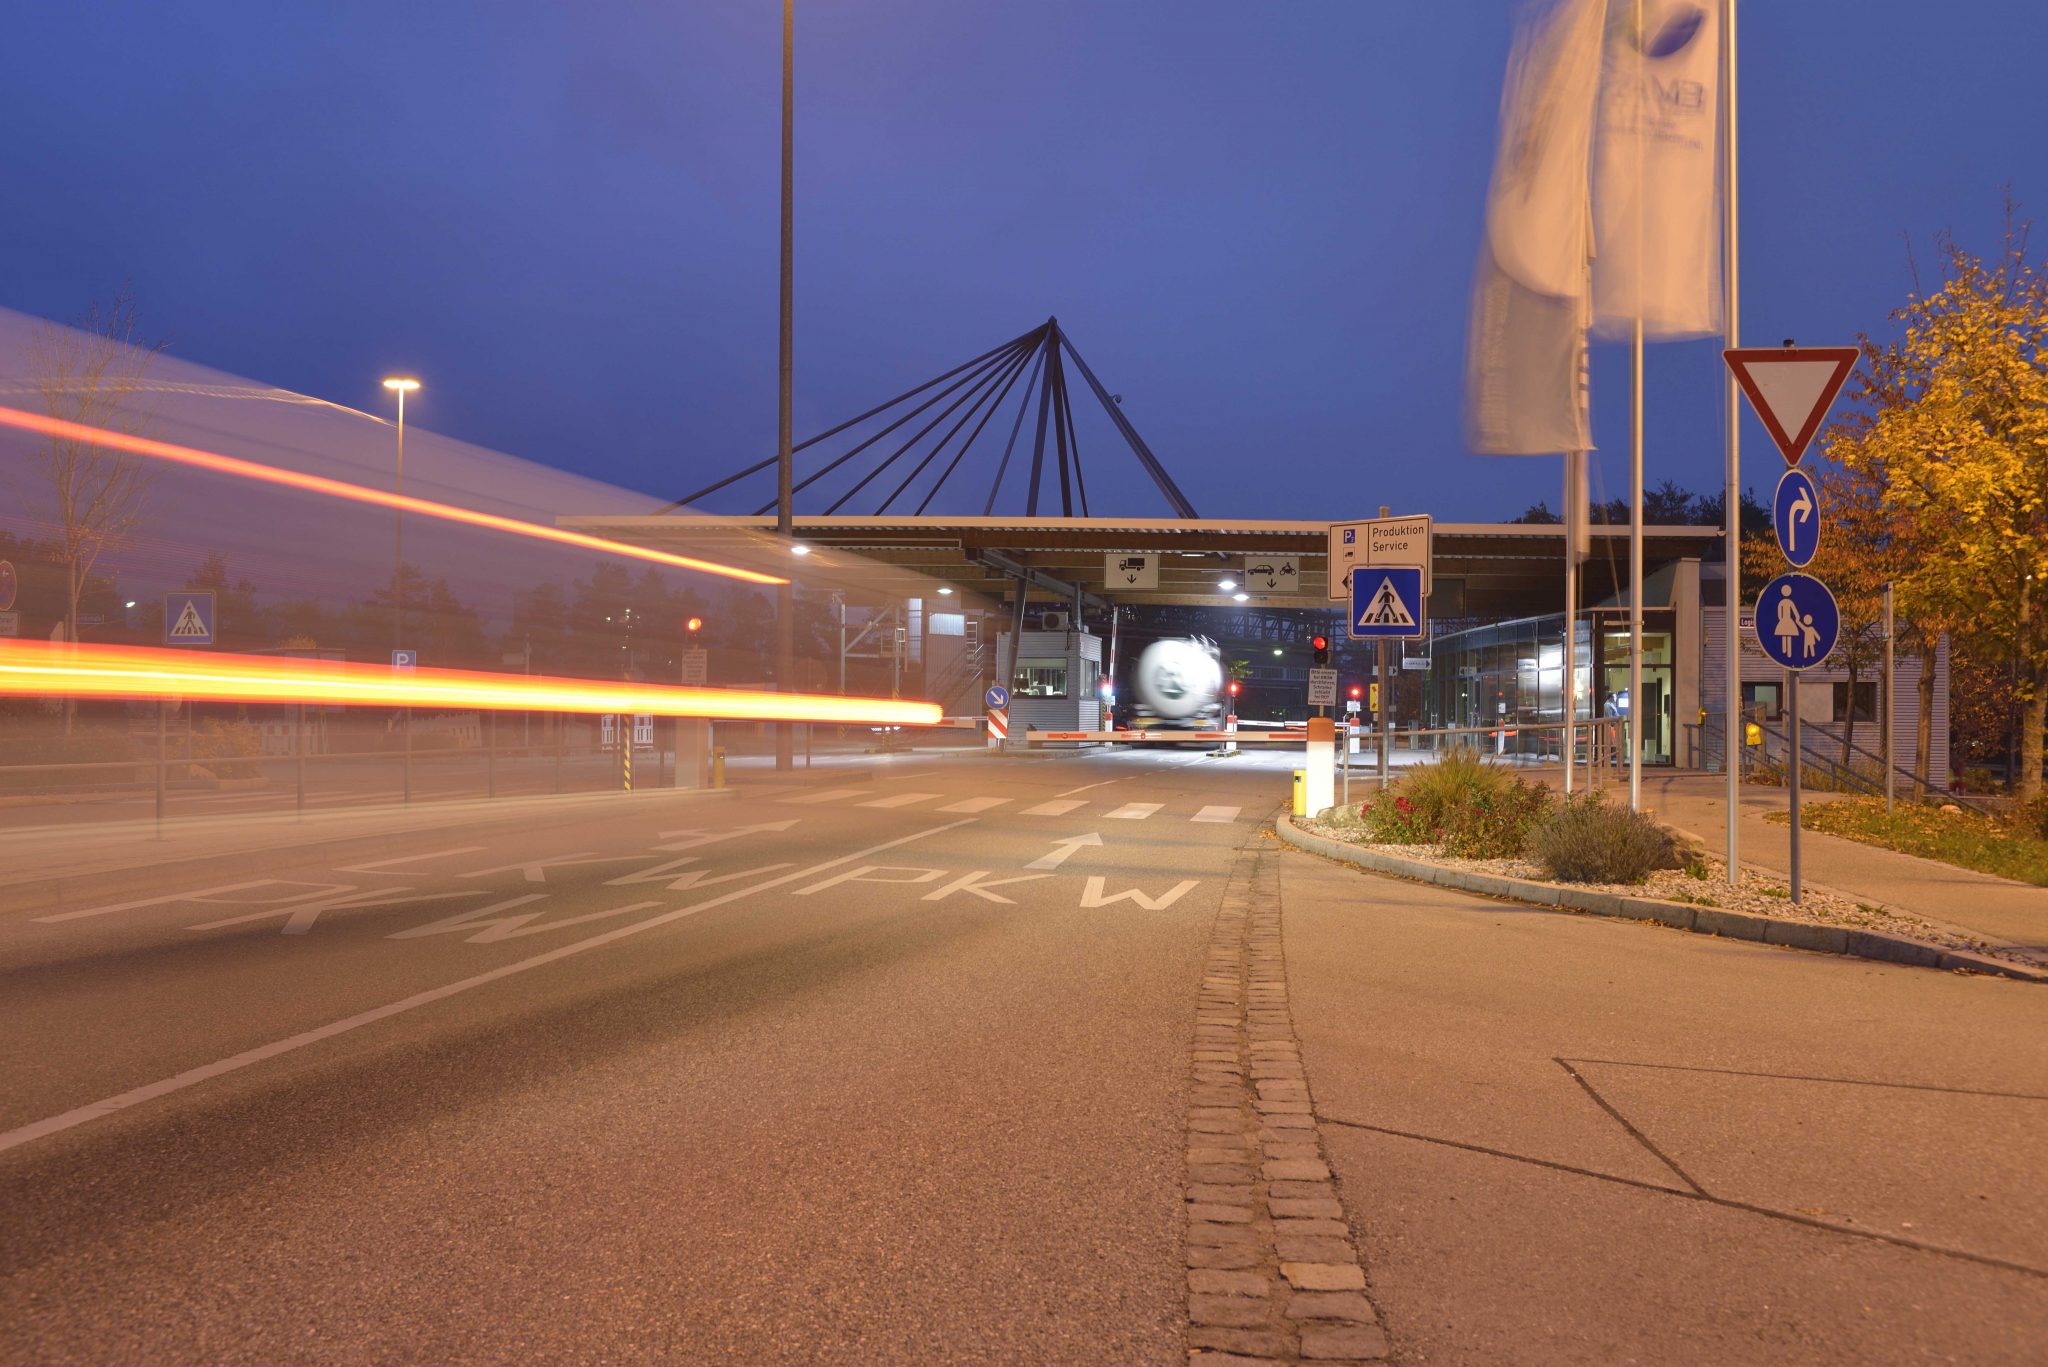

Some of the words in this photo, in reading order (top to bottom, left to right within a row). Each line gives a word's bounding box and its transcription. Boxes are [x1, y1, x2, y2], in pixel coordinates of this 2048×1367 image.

[1372, 526, 1424, 538] Produktion
[1372, 542, 1408, 552] Service
[1741, 618, 1754, 627] Logi
[396, 653, 409, 671] P
[332, 846, 798, 890] LKW
[790, 865, 1201, 911] PKW
[29, 879, 666, 944] PKW
